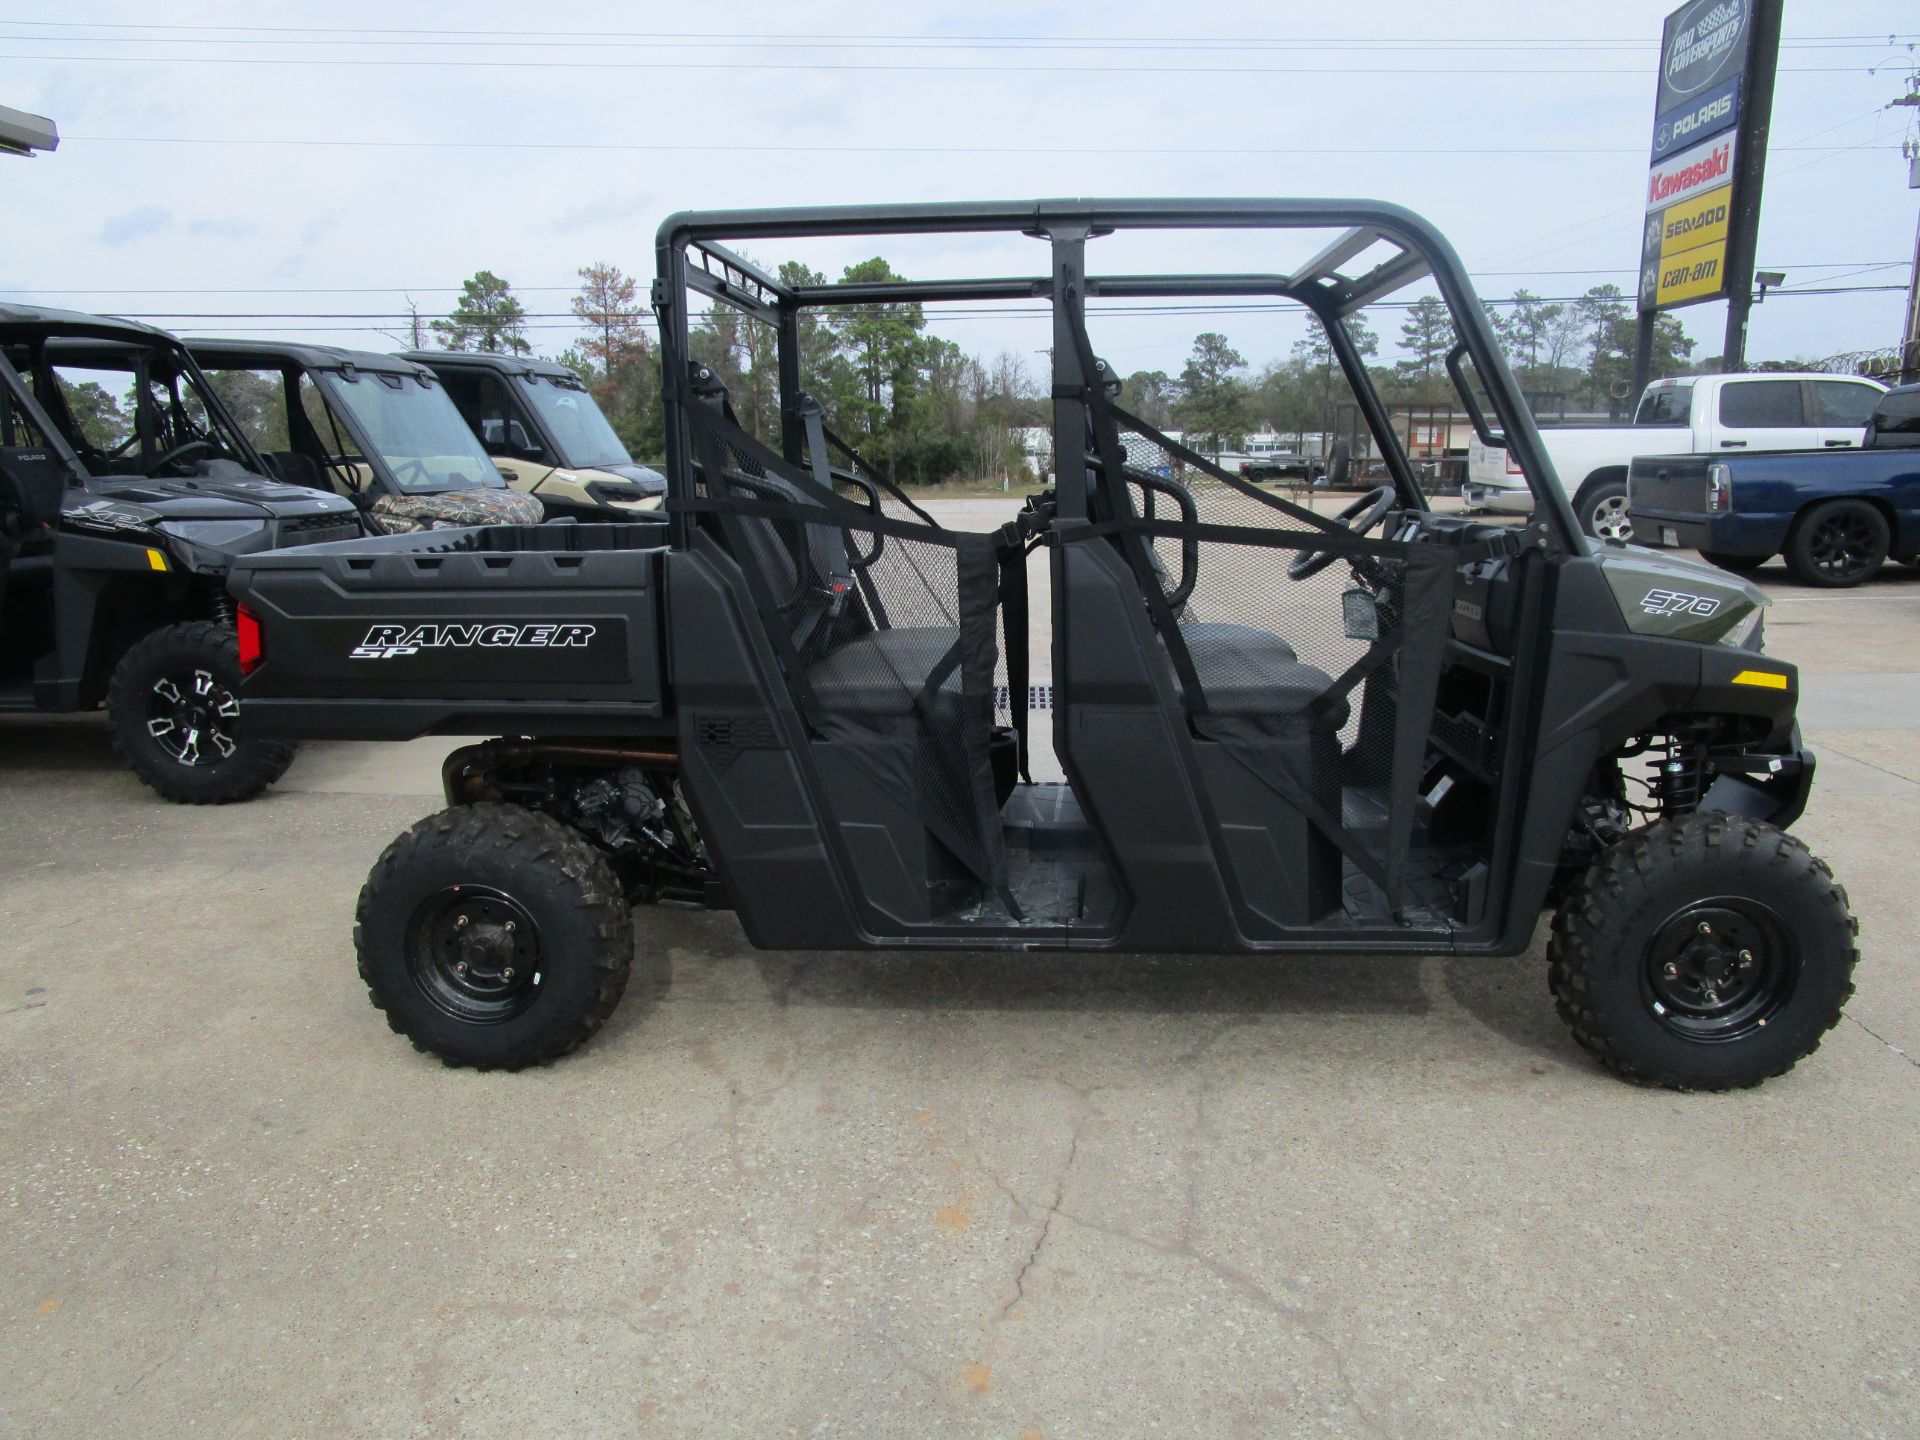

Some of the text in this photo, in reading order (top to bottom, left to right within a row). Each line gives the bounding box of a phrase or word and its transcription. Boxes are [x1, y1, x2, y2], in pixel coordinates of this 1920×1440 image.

[1673, 26, 1696, 56] PRO
[1672, 93, 1733, 139] POLARIS
[1649, 142, 1730, 202] Kawasaki
[1640, 588, 1720, 617] 570
[1643, 606, 1673, 617] EFI
[361, 624, 597, 647] RANGER
[349, 646, 420, 659] SP
